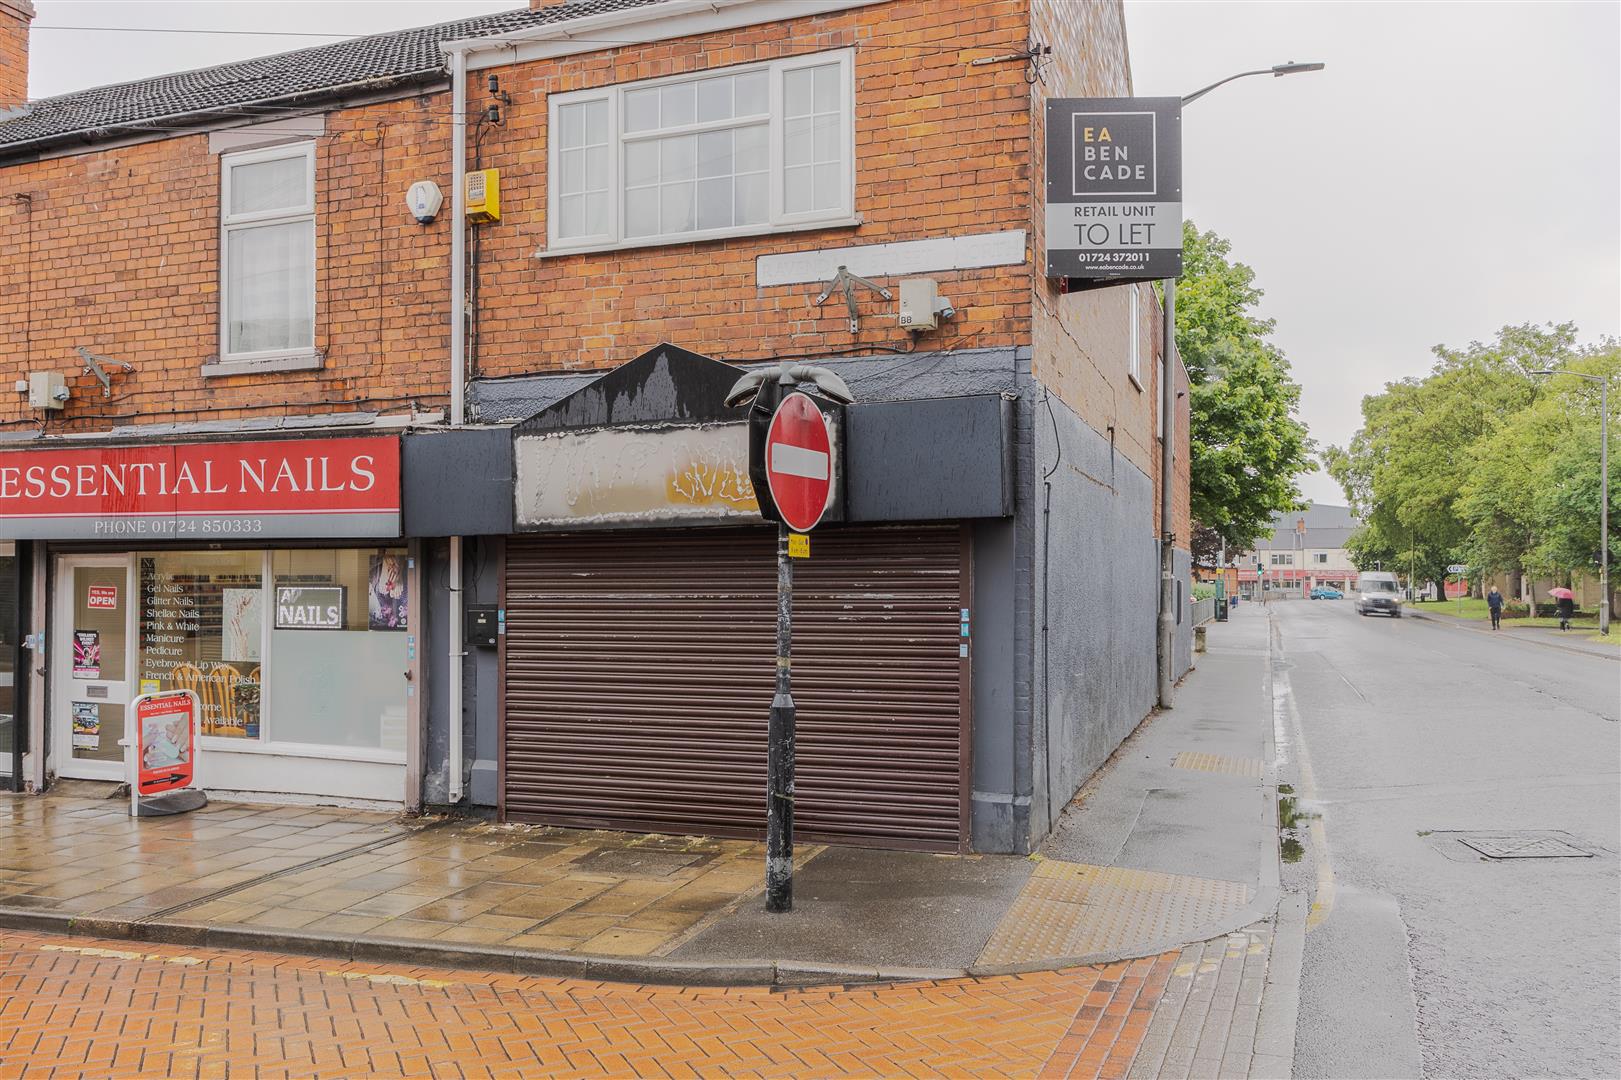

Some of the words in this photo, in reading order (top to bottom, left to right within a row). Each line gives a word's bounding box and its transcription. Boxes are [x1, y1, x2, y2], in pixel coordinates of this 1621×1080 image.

[1084, 127, 1112, 142] EA
[1084, 146, 1128, 161] BEN
[1084, 165, 1145, 180] CADE
[1074, 206, 1118, 217] RETAIL
[1122, 206, 1156, 217] UNIT
[1074, 223, 1110, 245] TO
[1119, 223, 1156, 245] LET
[1079, 253, 1111, 262] 01724
[1113, 253, 1149, 262] 372011
[1085, 263, 1144, 271] www.eabencade.co.uk
[0, 460, 228, 498] ESSENTIAL
[239, 455, 375, 493] NAILS
[95, 520, 146, 533] PHONE
[152, 520, 197, 533] 01724
[202, 519, 262, 533] 850333
[147, 584, 160, 593] Gel
[163, 584, 184, 593] Nails
[90, 596, 115, 605] OPEN
[147, 596, 170, 605] Glitter
[173, 597, 194, 606] Nails
[146, 609, 176, 618] Shellac
[179, 609, 200, 619] Nails
[279, 605, 339, 625] NAILS
[146, 622, 165, 630] Pink
[167, 622, 173, 630] &
[176, 622, 200, 631] White
[146, 634, 184, 643] Manicure
[146, 646, 183, 655] Pedicure
[146, 658, 183, 669] Eyebrow
[146, 672, 174, 680] French
[186, 673, 225, 683] American
[140, 701, 172, 711] ESSENTIAL
[174, 699, 191, 707] NAILS
[204, 716, 243, 726] Available
